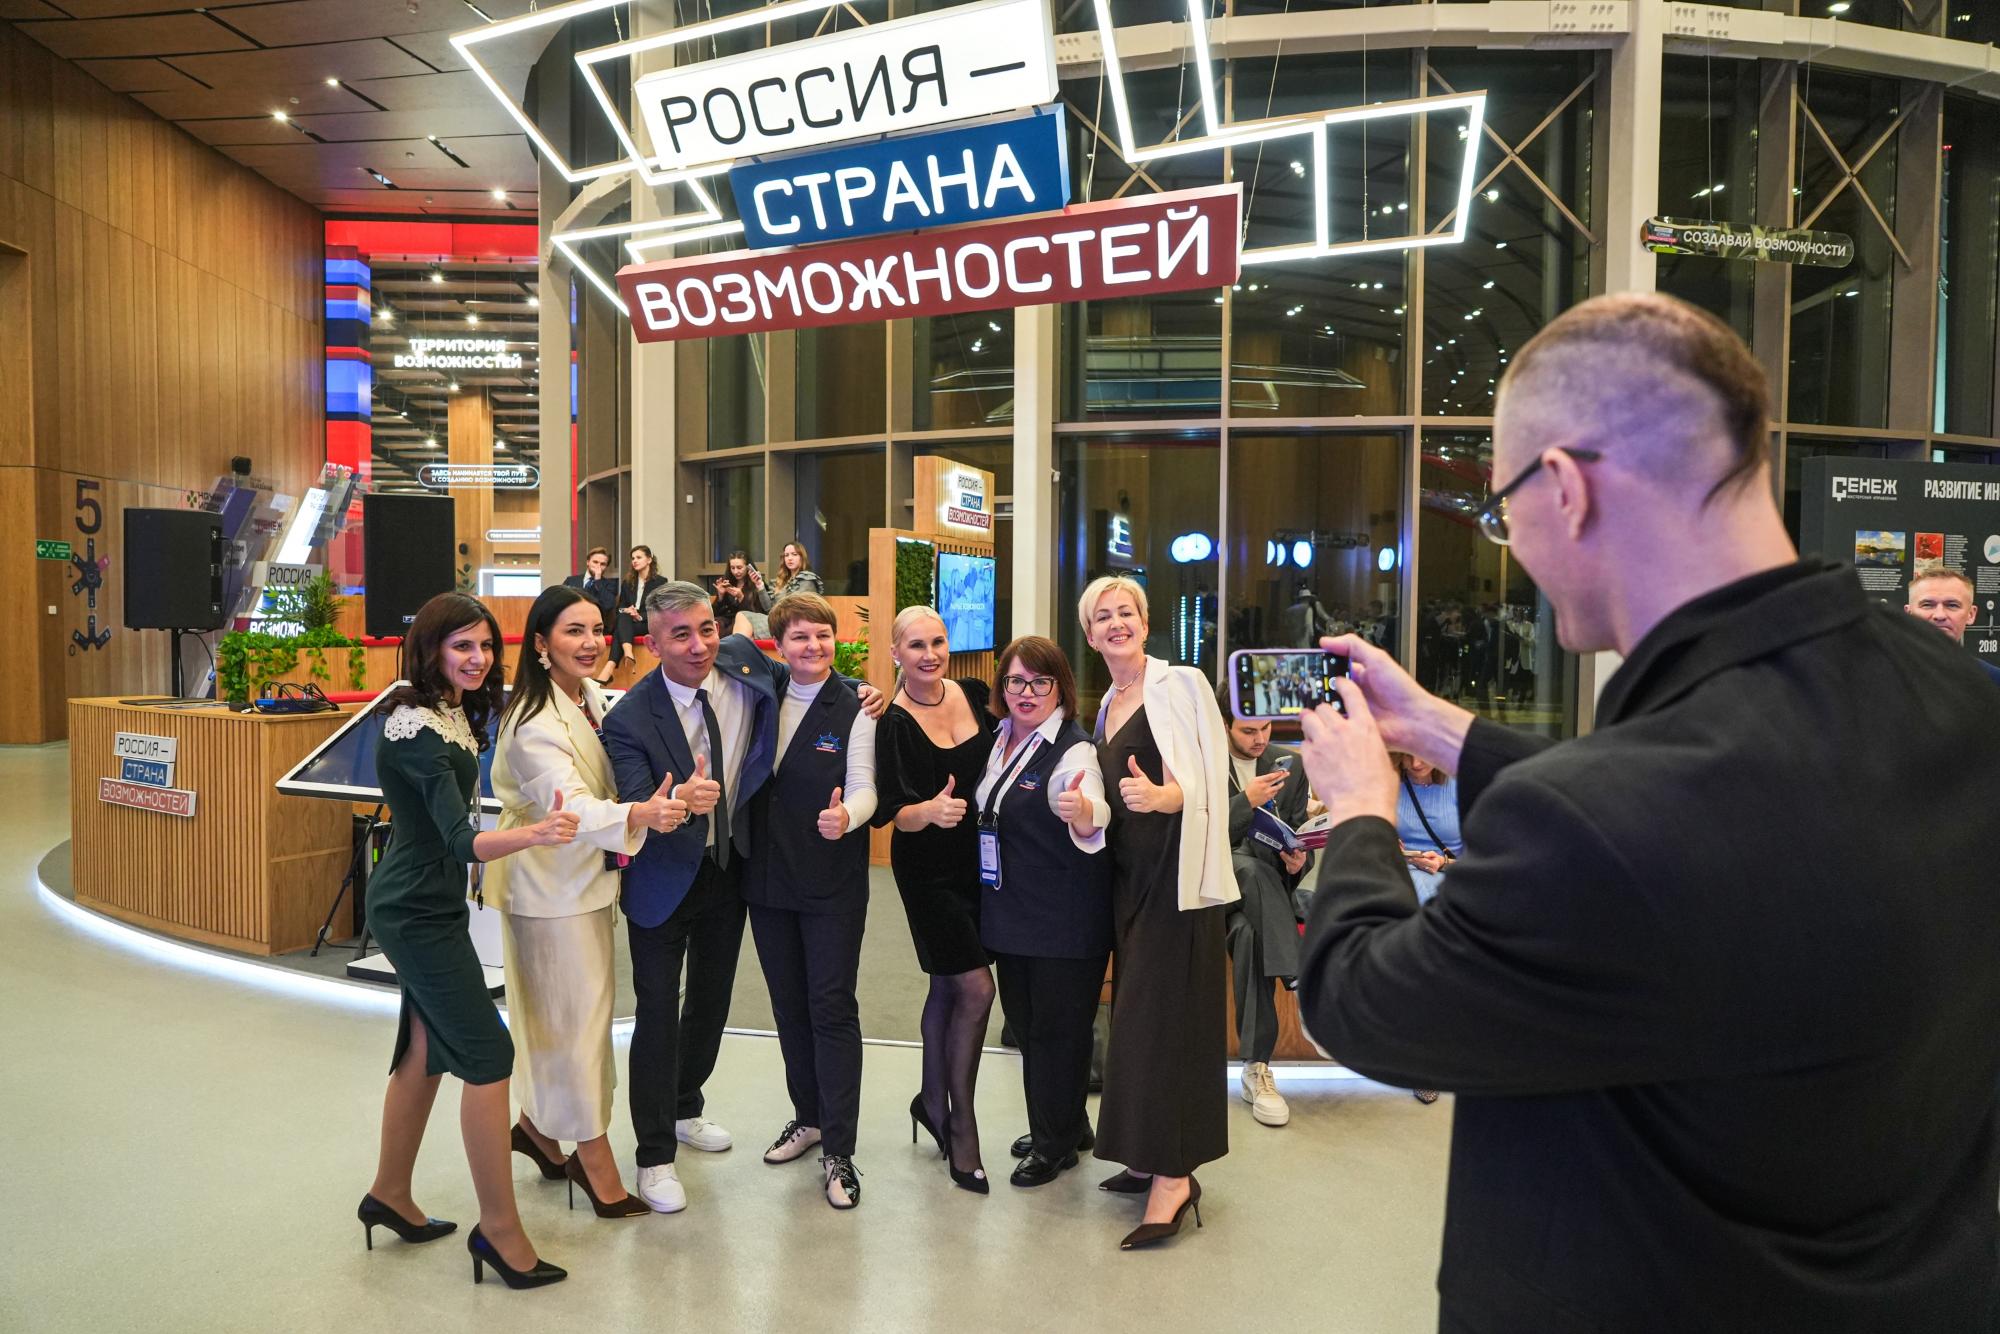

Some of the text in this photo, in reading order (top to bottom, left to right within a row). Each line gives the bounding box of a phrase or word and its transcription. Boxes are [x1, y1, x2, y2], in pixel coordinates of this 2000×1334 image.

[660, 44, 948, 154] РОССИЯ
[752, 143, 1036, 236] СТРАНА
[1683, 230, 1751, 248] СОЗДАВАЙ
[1754, 237, 1846, 257] ВОЗМОЖНОСТИ
[635, 205, 1210, 331] ВОЗМОЖНОСТЕЙ
[408, 339, 506, 352] ТЕРРИТОРИЯ
[394, 353, 522, 369] ВОЗМОЖНОСТЕЙ
[474, 476, 527, 484] ВОЗМОЖНОСТЕЙ
[493, 469, 510, 477] ТВОЙ
[957, 474, 978, 491] РОССИЯ
[1832, 476, 1898, 502] СЕНЕЖ
[1924, 479, 1982, 500] РАЗВИТИЕ
[75, 479, 102, 535] 5
[961, 494, 981, 508] СТРАНА
[948, 509, 989, 527] ВОЗМОЖНОСТЕЙ
[268, 566, 312, 585] РОССИЯ
[1979, 640, 1997, 653] 2018
[118, 737, 159, 757] РОССИЯ
[125, 763, 165, 783] СТРАНА
[103, 782, 188, 811] ВОЗМОЖНОСТЕЙ
